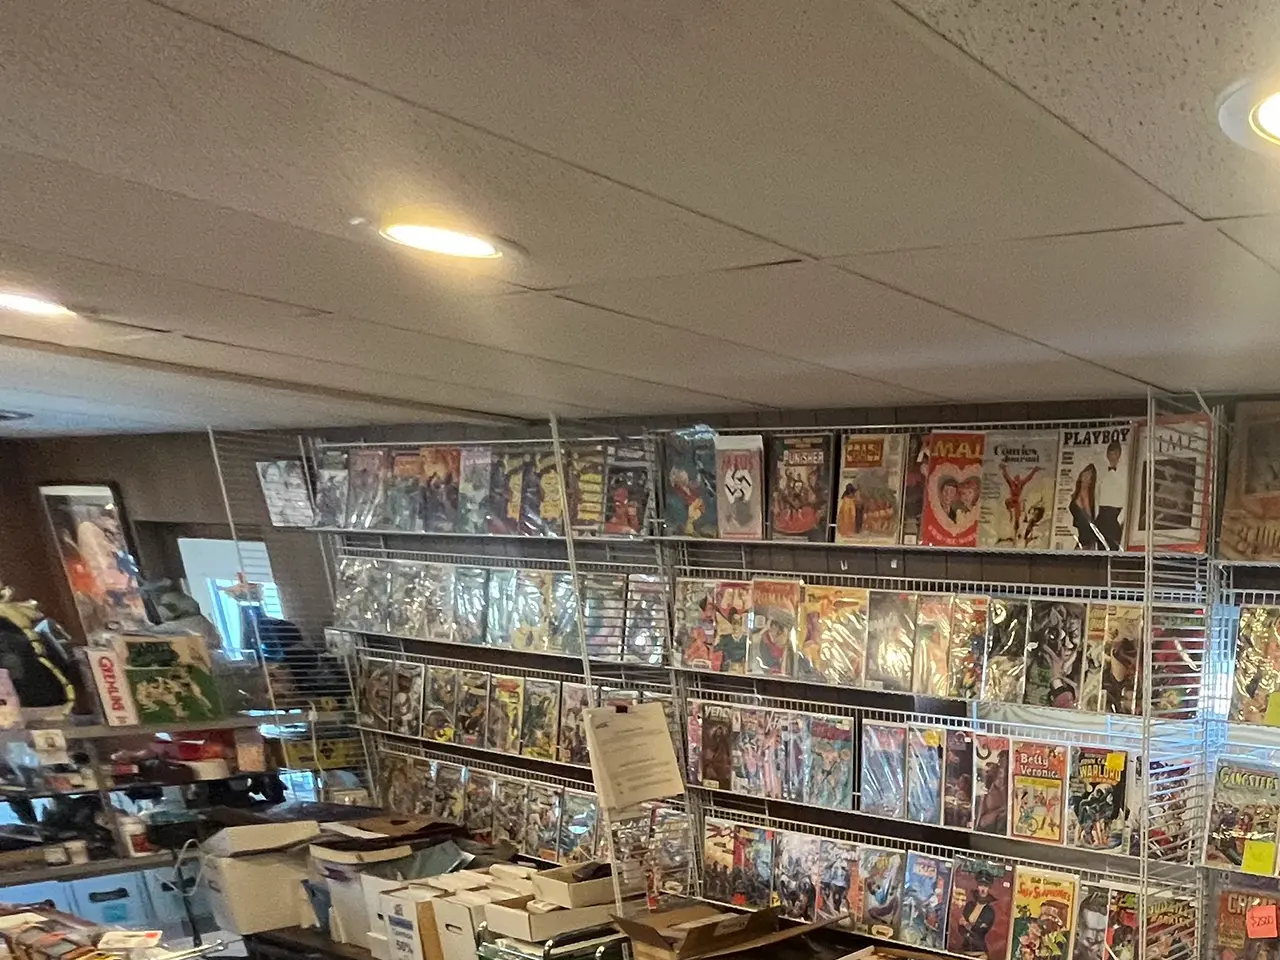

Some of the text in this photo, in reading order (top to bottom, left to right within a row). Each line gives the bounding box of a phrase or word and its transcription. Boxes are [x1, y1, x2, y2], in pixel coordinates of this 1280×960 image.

[1063, 428, 1130, 446] PLAYBOY
[1158, 434, 1199, 452] IME
[993, 444, 1038, 457] Comics
[1019, 753, 1049, 768] Betty
[1019, 765, 1060, 779] Veronica
[1218, 764, 1280, 791] GANGSTERS
